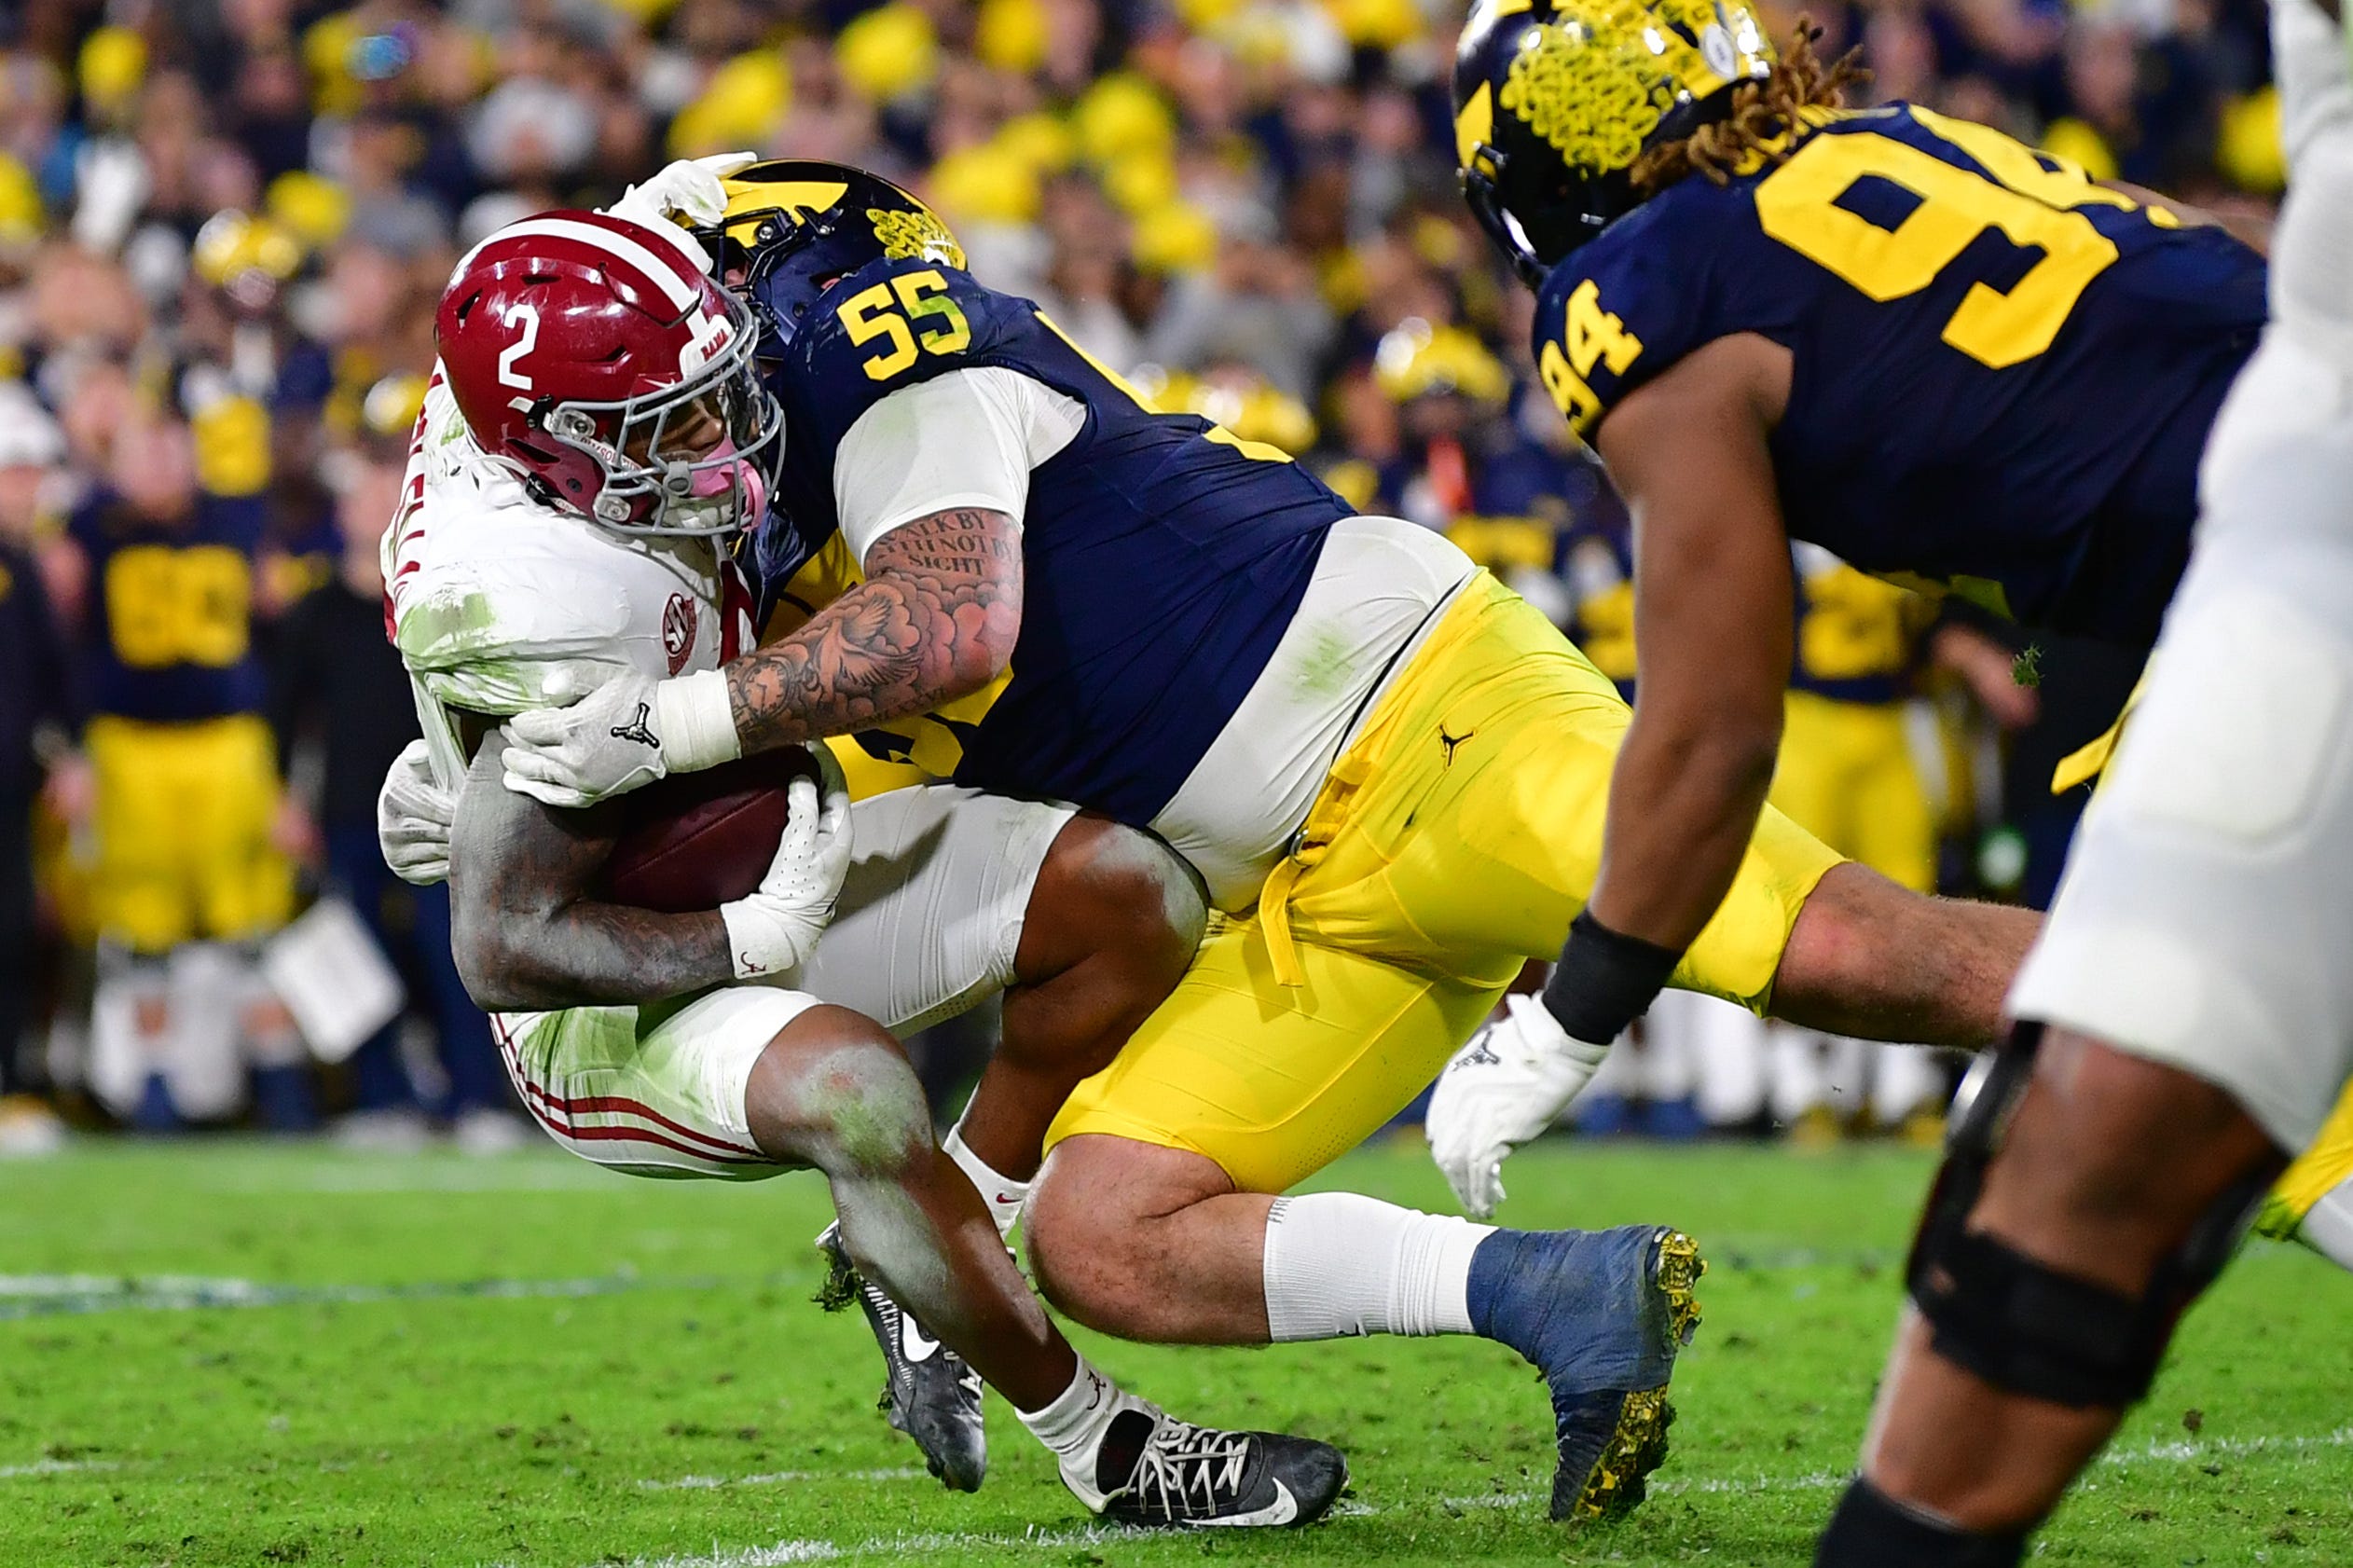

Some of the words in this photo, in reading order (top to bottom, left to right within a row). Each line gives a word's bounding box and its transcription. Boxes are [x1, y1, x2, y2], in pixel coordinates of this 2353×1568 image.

[836, 269, 971, 381] 55
[498, 303, 540, 391] 2
[700, 327, 729, 363] BAMA
[1539, 278, 1644, 447] 94
[956, 511, 986, 530] BY
[938, 534, 989, 556] NOT
[907, 555, 985, 576] SIGHT
